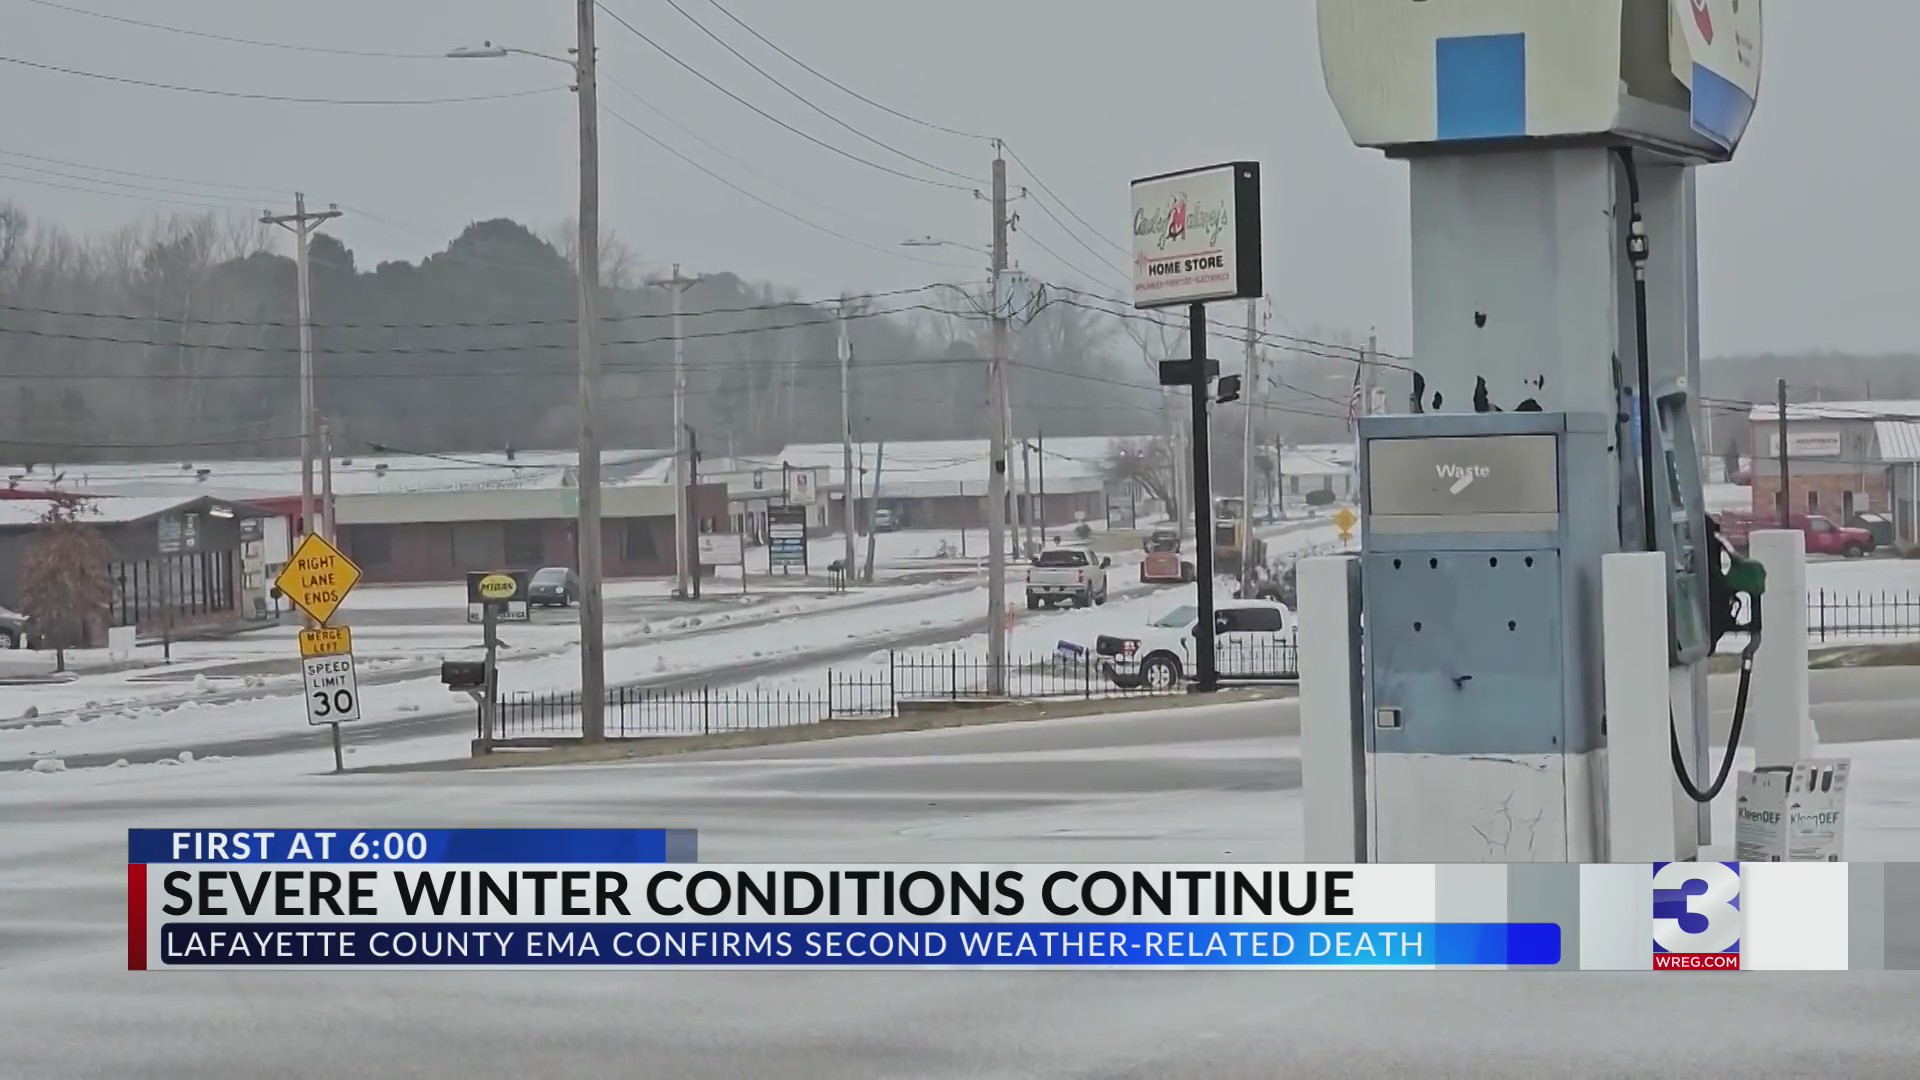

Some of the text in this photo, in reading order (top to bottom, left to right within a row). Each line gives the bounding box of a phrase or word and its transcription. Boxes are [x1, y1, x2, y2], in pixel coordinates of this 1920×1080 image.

[1149, 256, 1224, 276] HOME STORE
[1436, 464, 1490, 478] Waste
[298, 555, 336, 571] RIGHT
[302, 573, 336, 588] LANE
[304, 589, 339, 605] ENDS
[306, 630, 342, 641] MERGE
[313, 641, 338, 653] LEFT
[307, 661, 350, 676] SPEED
[313, 675, 346, 688] LIMIT
[313, 689, 353, 716] 30
[1738, 807, 1781, 824] KleenDEF
